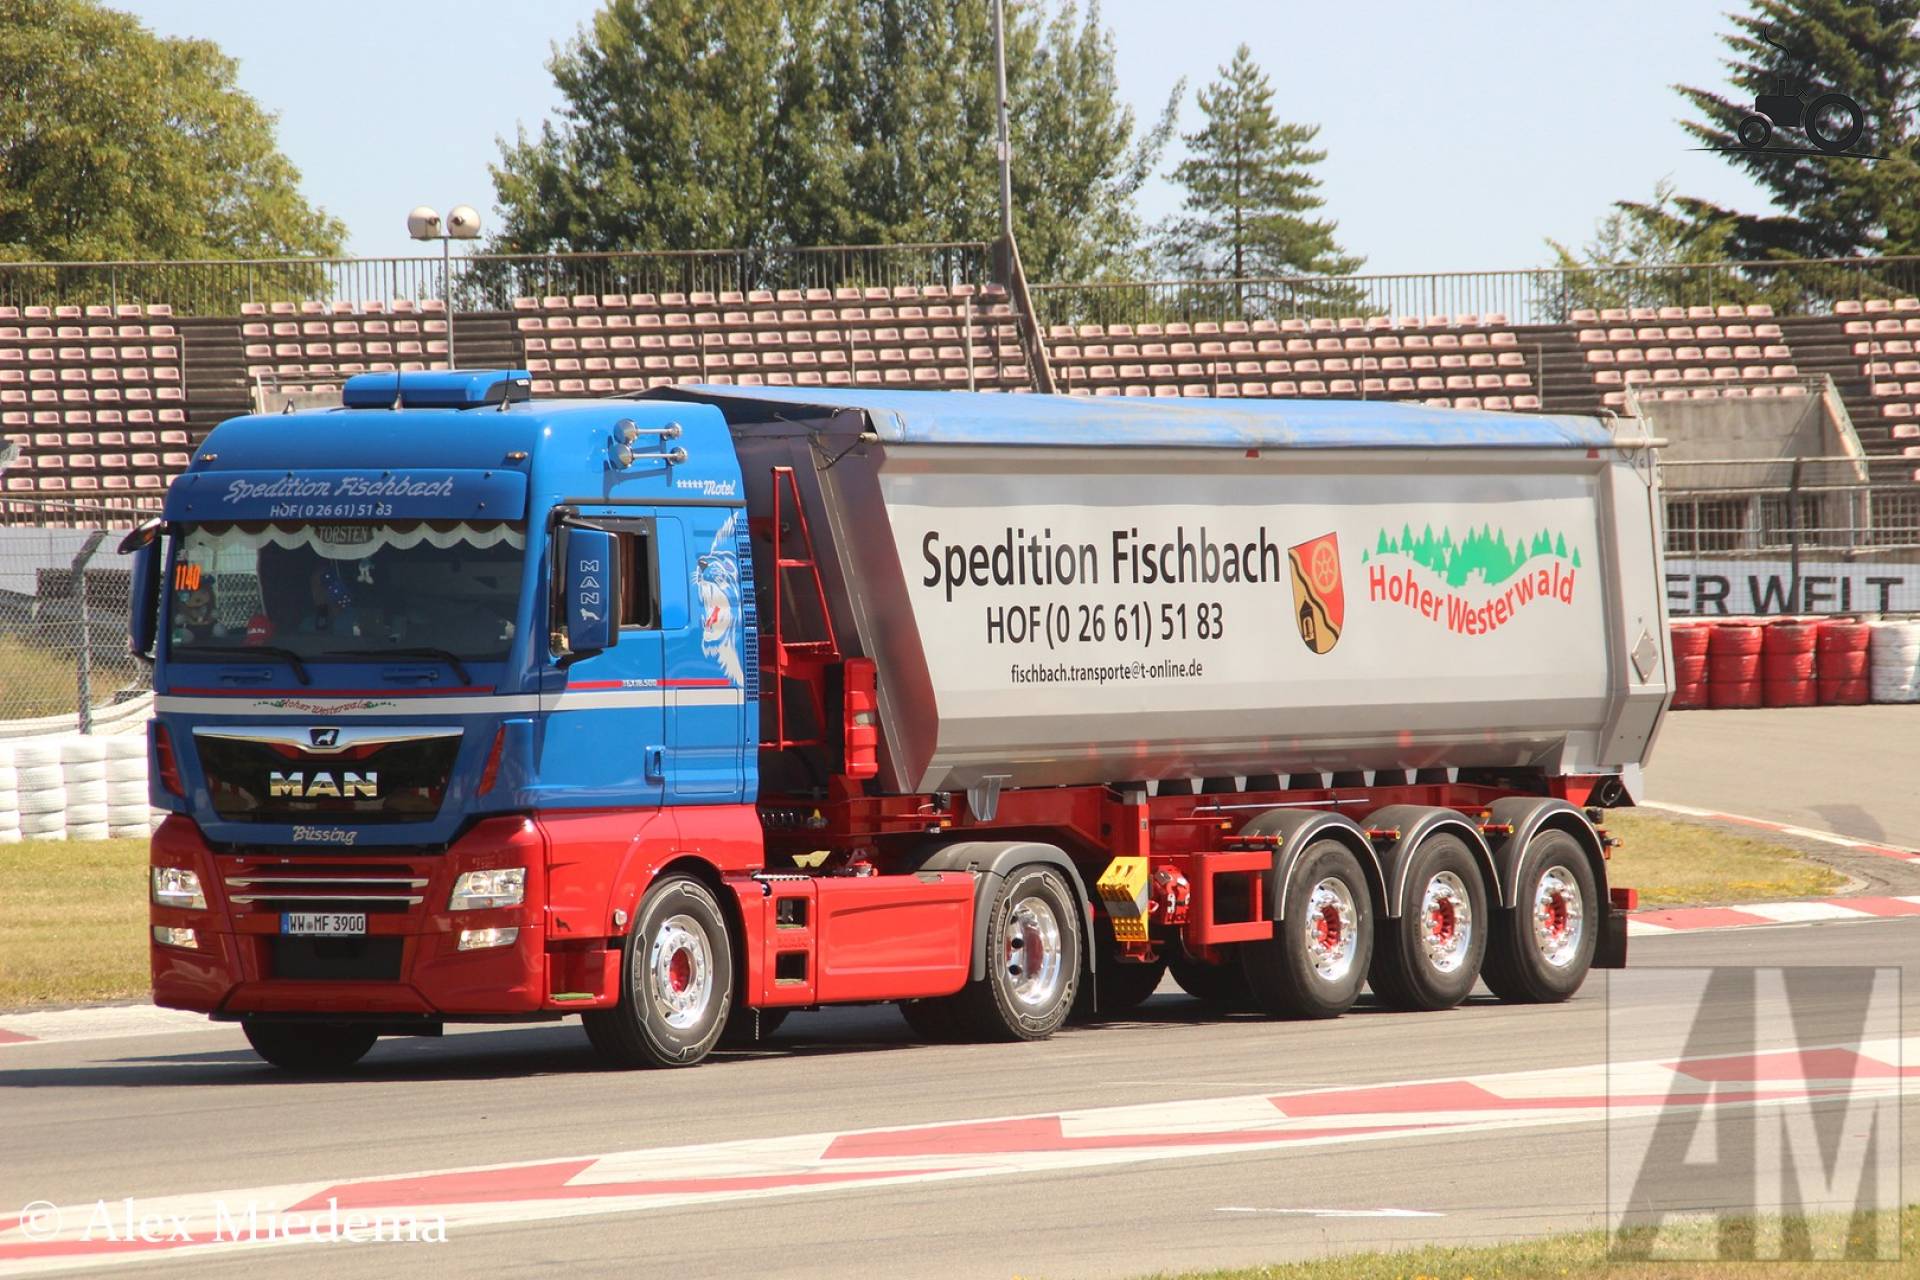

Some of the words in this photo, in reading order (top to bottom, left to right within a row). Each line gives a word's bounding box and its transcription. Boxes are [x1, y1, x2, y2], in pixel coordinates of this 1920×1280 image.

[223, 478, 331, 503] Spedition
[335, 476, 454, 497] Fischbach
[316, 504, 333, 516] 26
[334, 503, 356, 518] 61)
[357, 504, 373, 516] 51
[376, 503, 393, 516] 83
[175, 563, 202, 591] 1140
[922, 527, 1098, 603] Spedition
[1112, 526, 1281, 585] Fischbach
[580, 559, 600, 605] MAN
[1369, 564, 1443, 622] Hoher
[1078, 604, 1106, 643] 26
[1114, 601, 1152, 648] 61)
[1161, 603, 1187, 640] 51
[1197, 602, 1224, 640] 83
[1011, 658, 1203, 685] fischbach.transporte@t-online.de
[269, 771, 378, 798] MAN
[293, 825, 358, 846] Büssing
[289, 915, 305, 931] WW
[314, 915, 330, 931] MF
[333, 915, 364, 932] 3900
